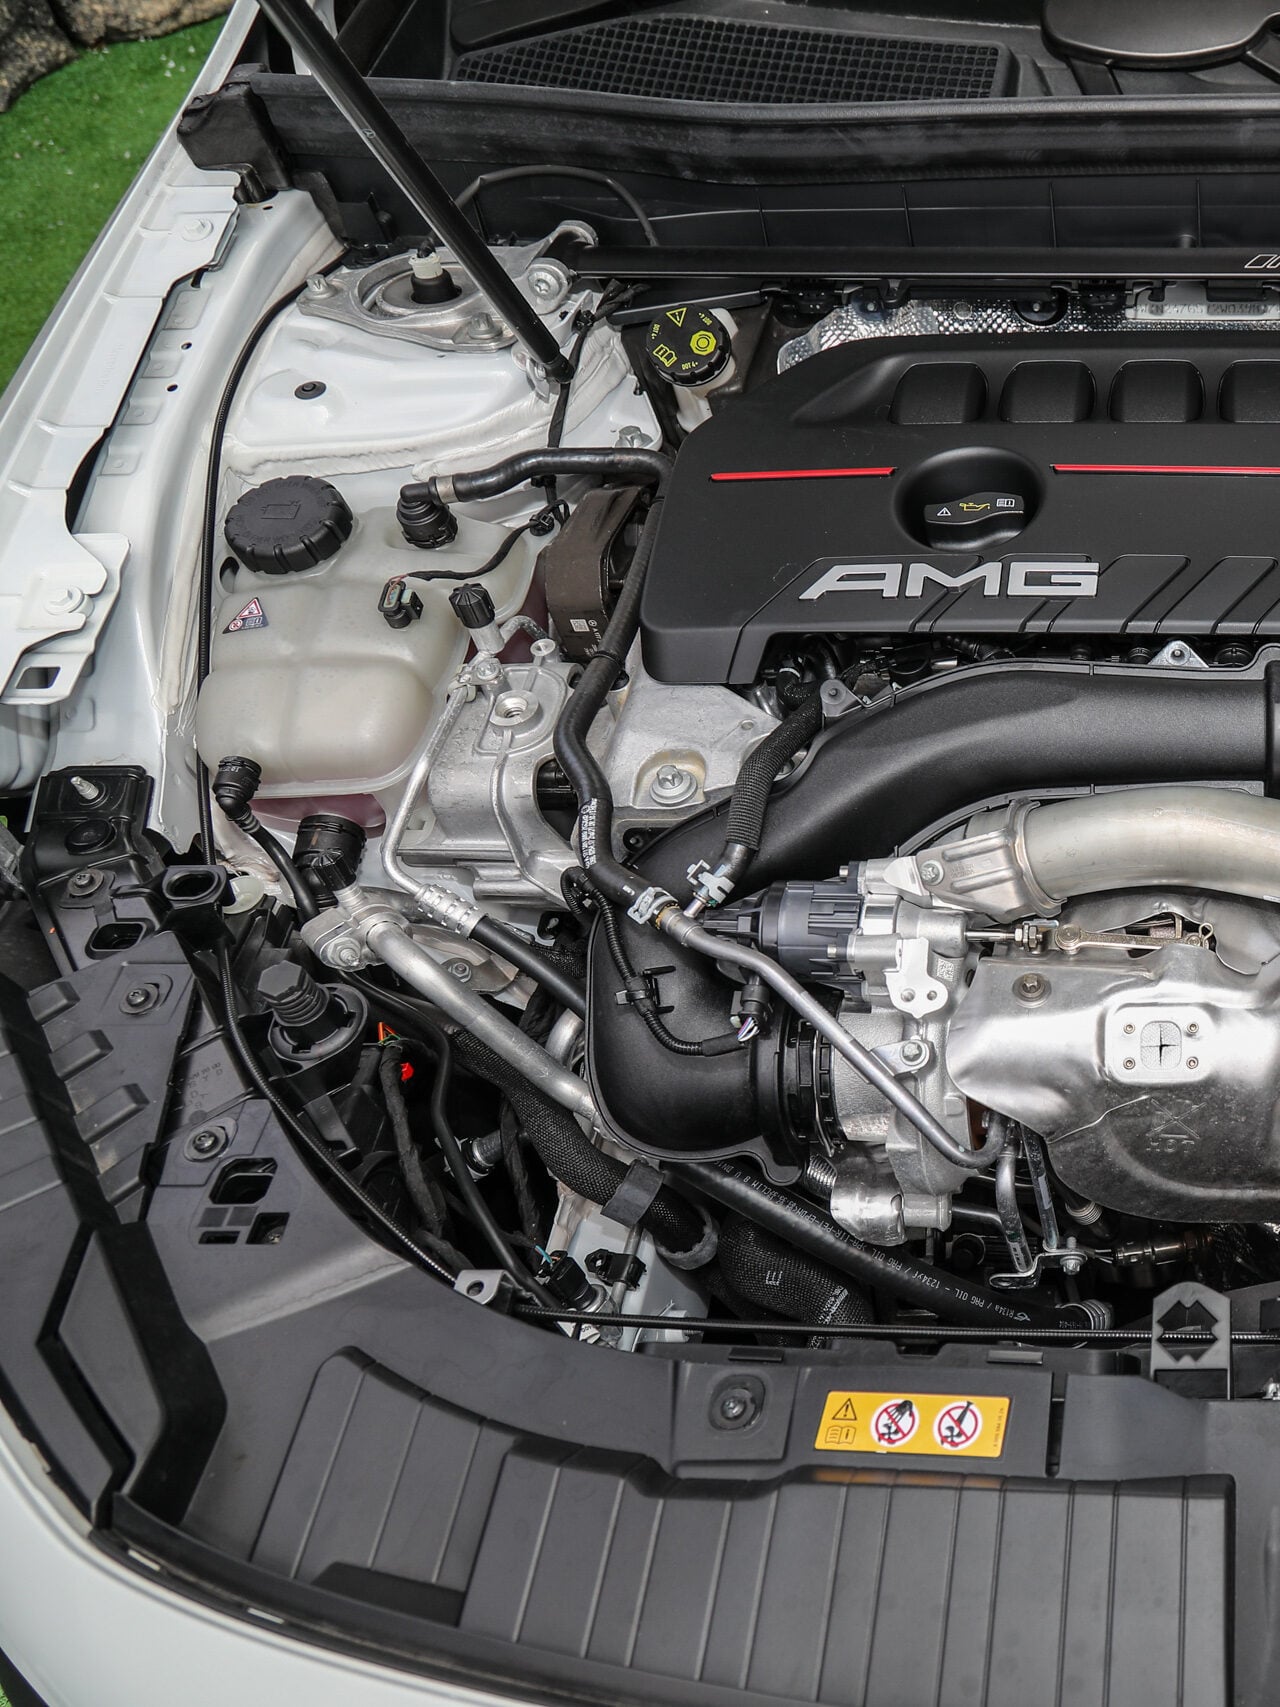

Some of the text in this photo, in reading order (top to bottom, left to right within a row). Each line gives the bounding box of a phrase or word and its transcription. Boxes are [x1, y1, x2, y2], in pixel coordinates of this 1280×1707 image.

[799, 561, 1100, 600] AMG
[868, 1247, 886, 1262] OIL
[885, 1256, 903, 1271] PAG
[910, 1269, 942, 1289] 1234yf
[951, 1287, 969, 1301] OIL
[969, 1294, 985, 1308] PAG
